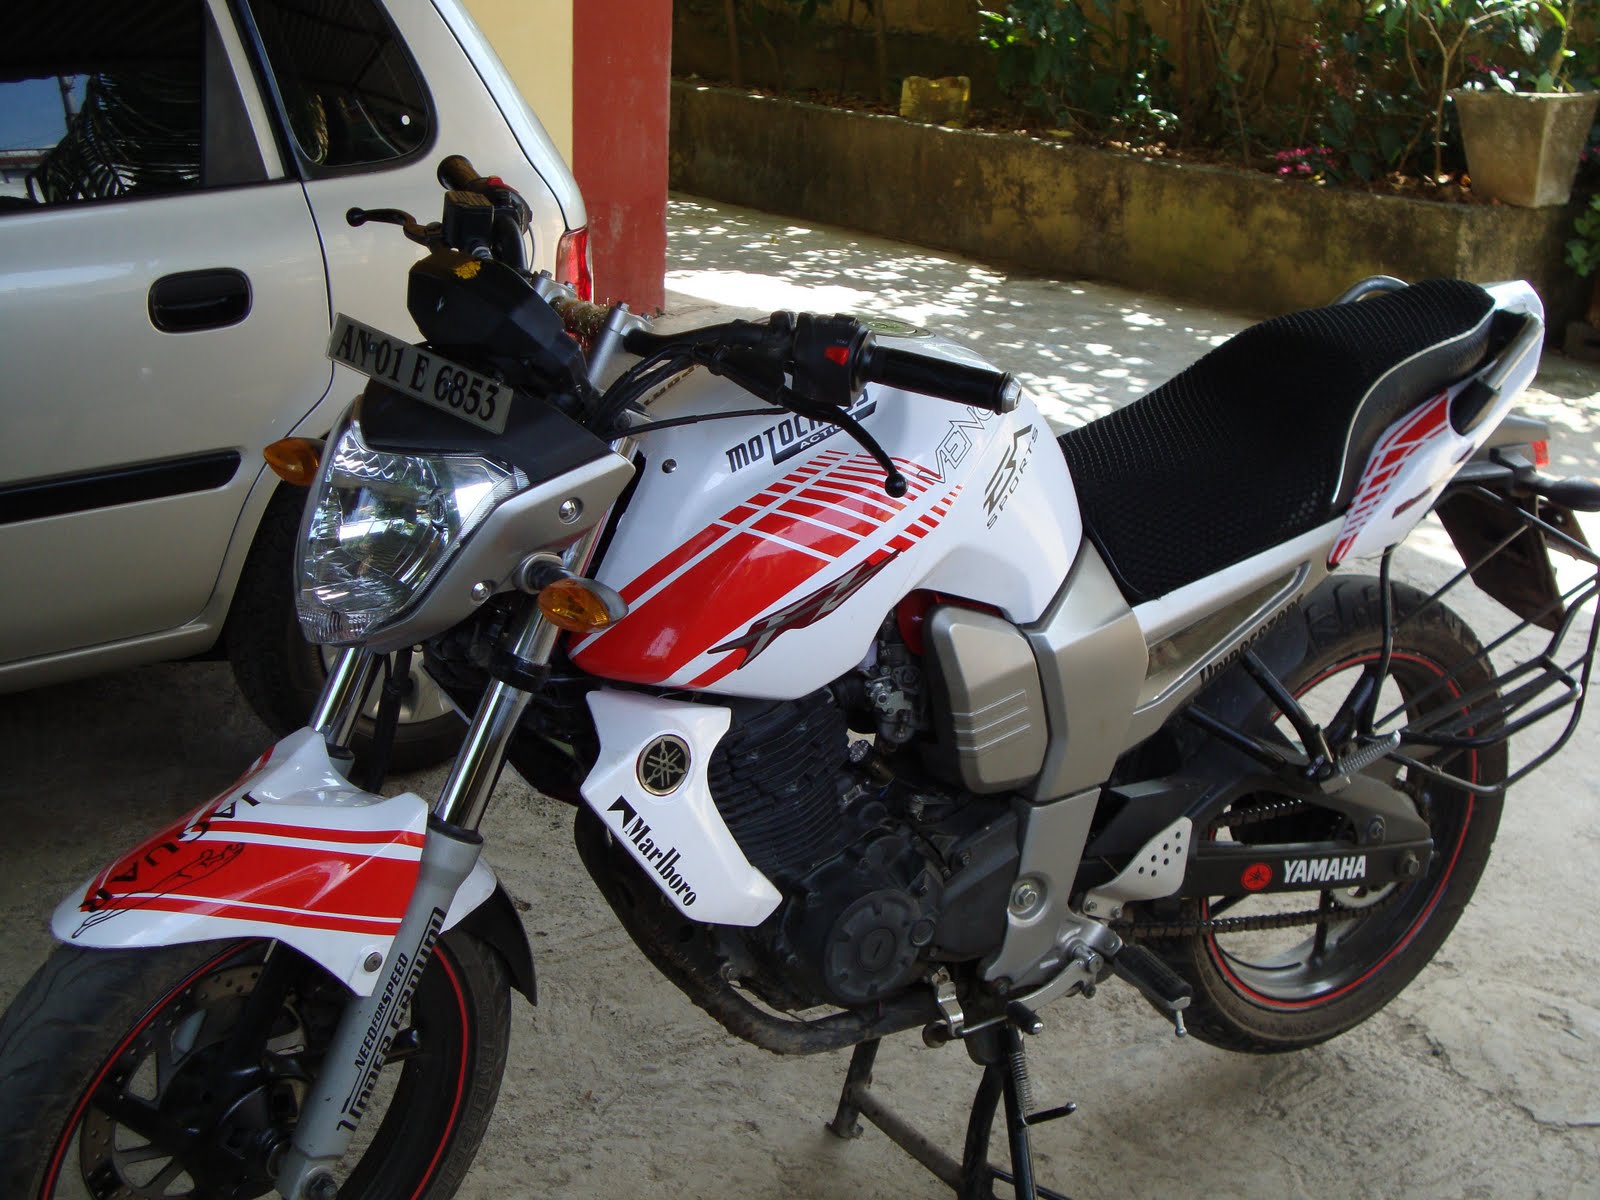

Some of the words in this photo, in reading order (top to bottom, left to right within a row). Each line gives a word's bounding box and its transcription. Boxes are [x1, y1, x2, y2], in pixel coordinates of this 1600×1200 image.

[336, 325, 371, 367] AN
[374, 340, 405, 382] 01
[409, 353, 429, 392] E
[434, 365, 499, 421] 6853
[725, 388, 869, 473] MOTOC
[986, 427, 1039, 530] SPORTS
[78, 791, 261, 913] JAGUAR
[624, 816, 697, 907] Marlboro
[1284, 855, 1366, 884] YAMAHA
